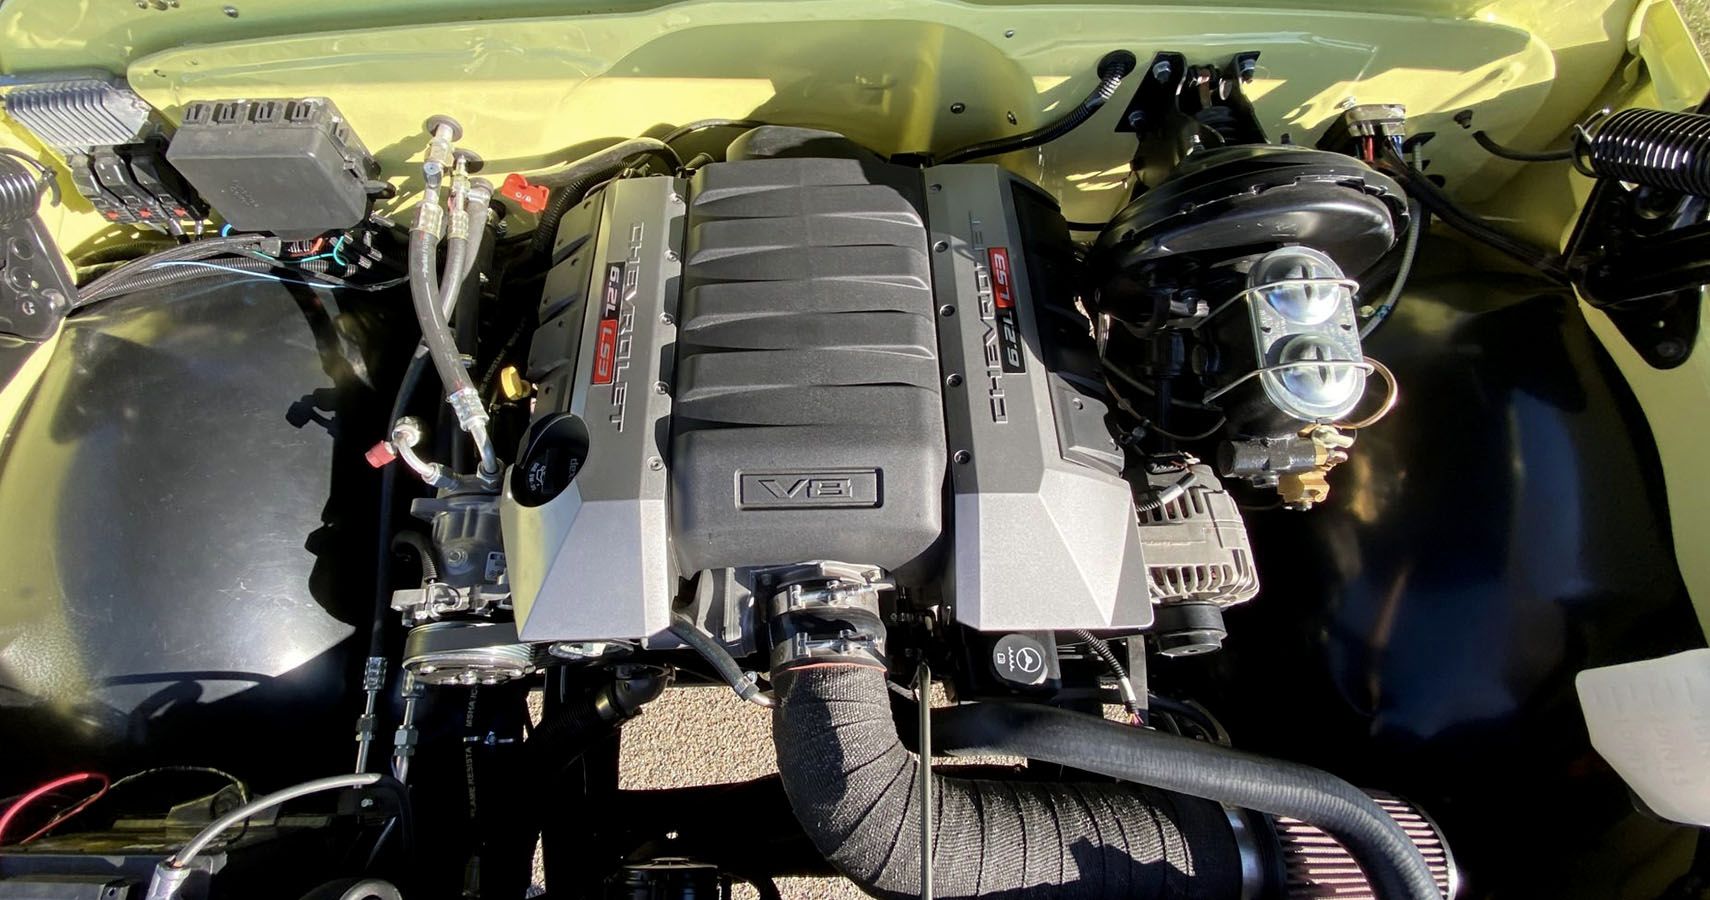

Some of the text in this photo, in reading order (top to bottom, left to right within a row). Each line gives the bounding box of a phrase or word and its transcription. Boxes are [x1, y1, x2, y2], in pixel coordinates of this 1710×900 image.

[599, 265, 621, 377] 6.2L LS3
[609, 222, 645, 433] CHEVROLET
[968, 209, 1008, 424] CHEVROLET
[993, 253, 1020, 368] 6.2L LS3
[758, 478, 853, 499] V8
[464, 746, 475, 785] RESISTA
